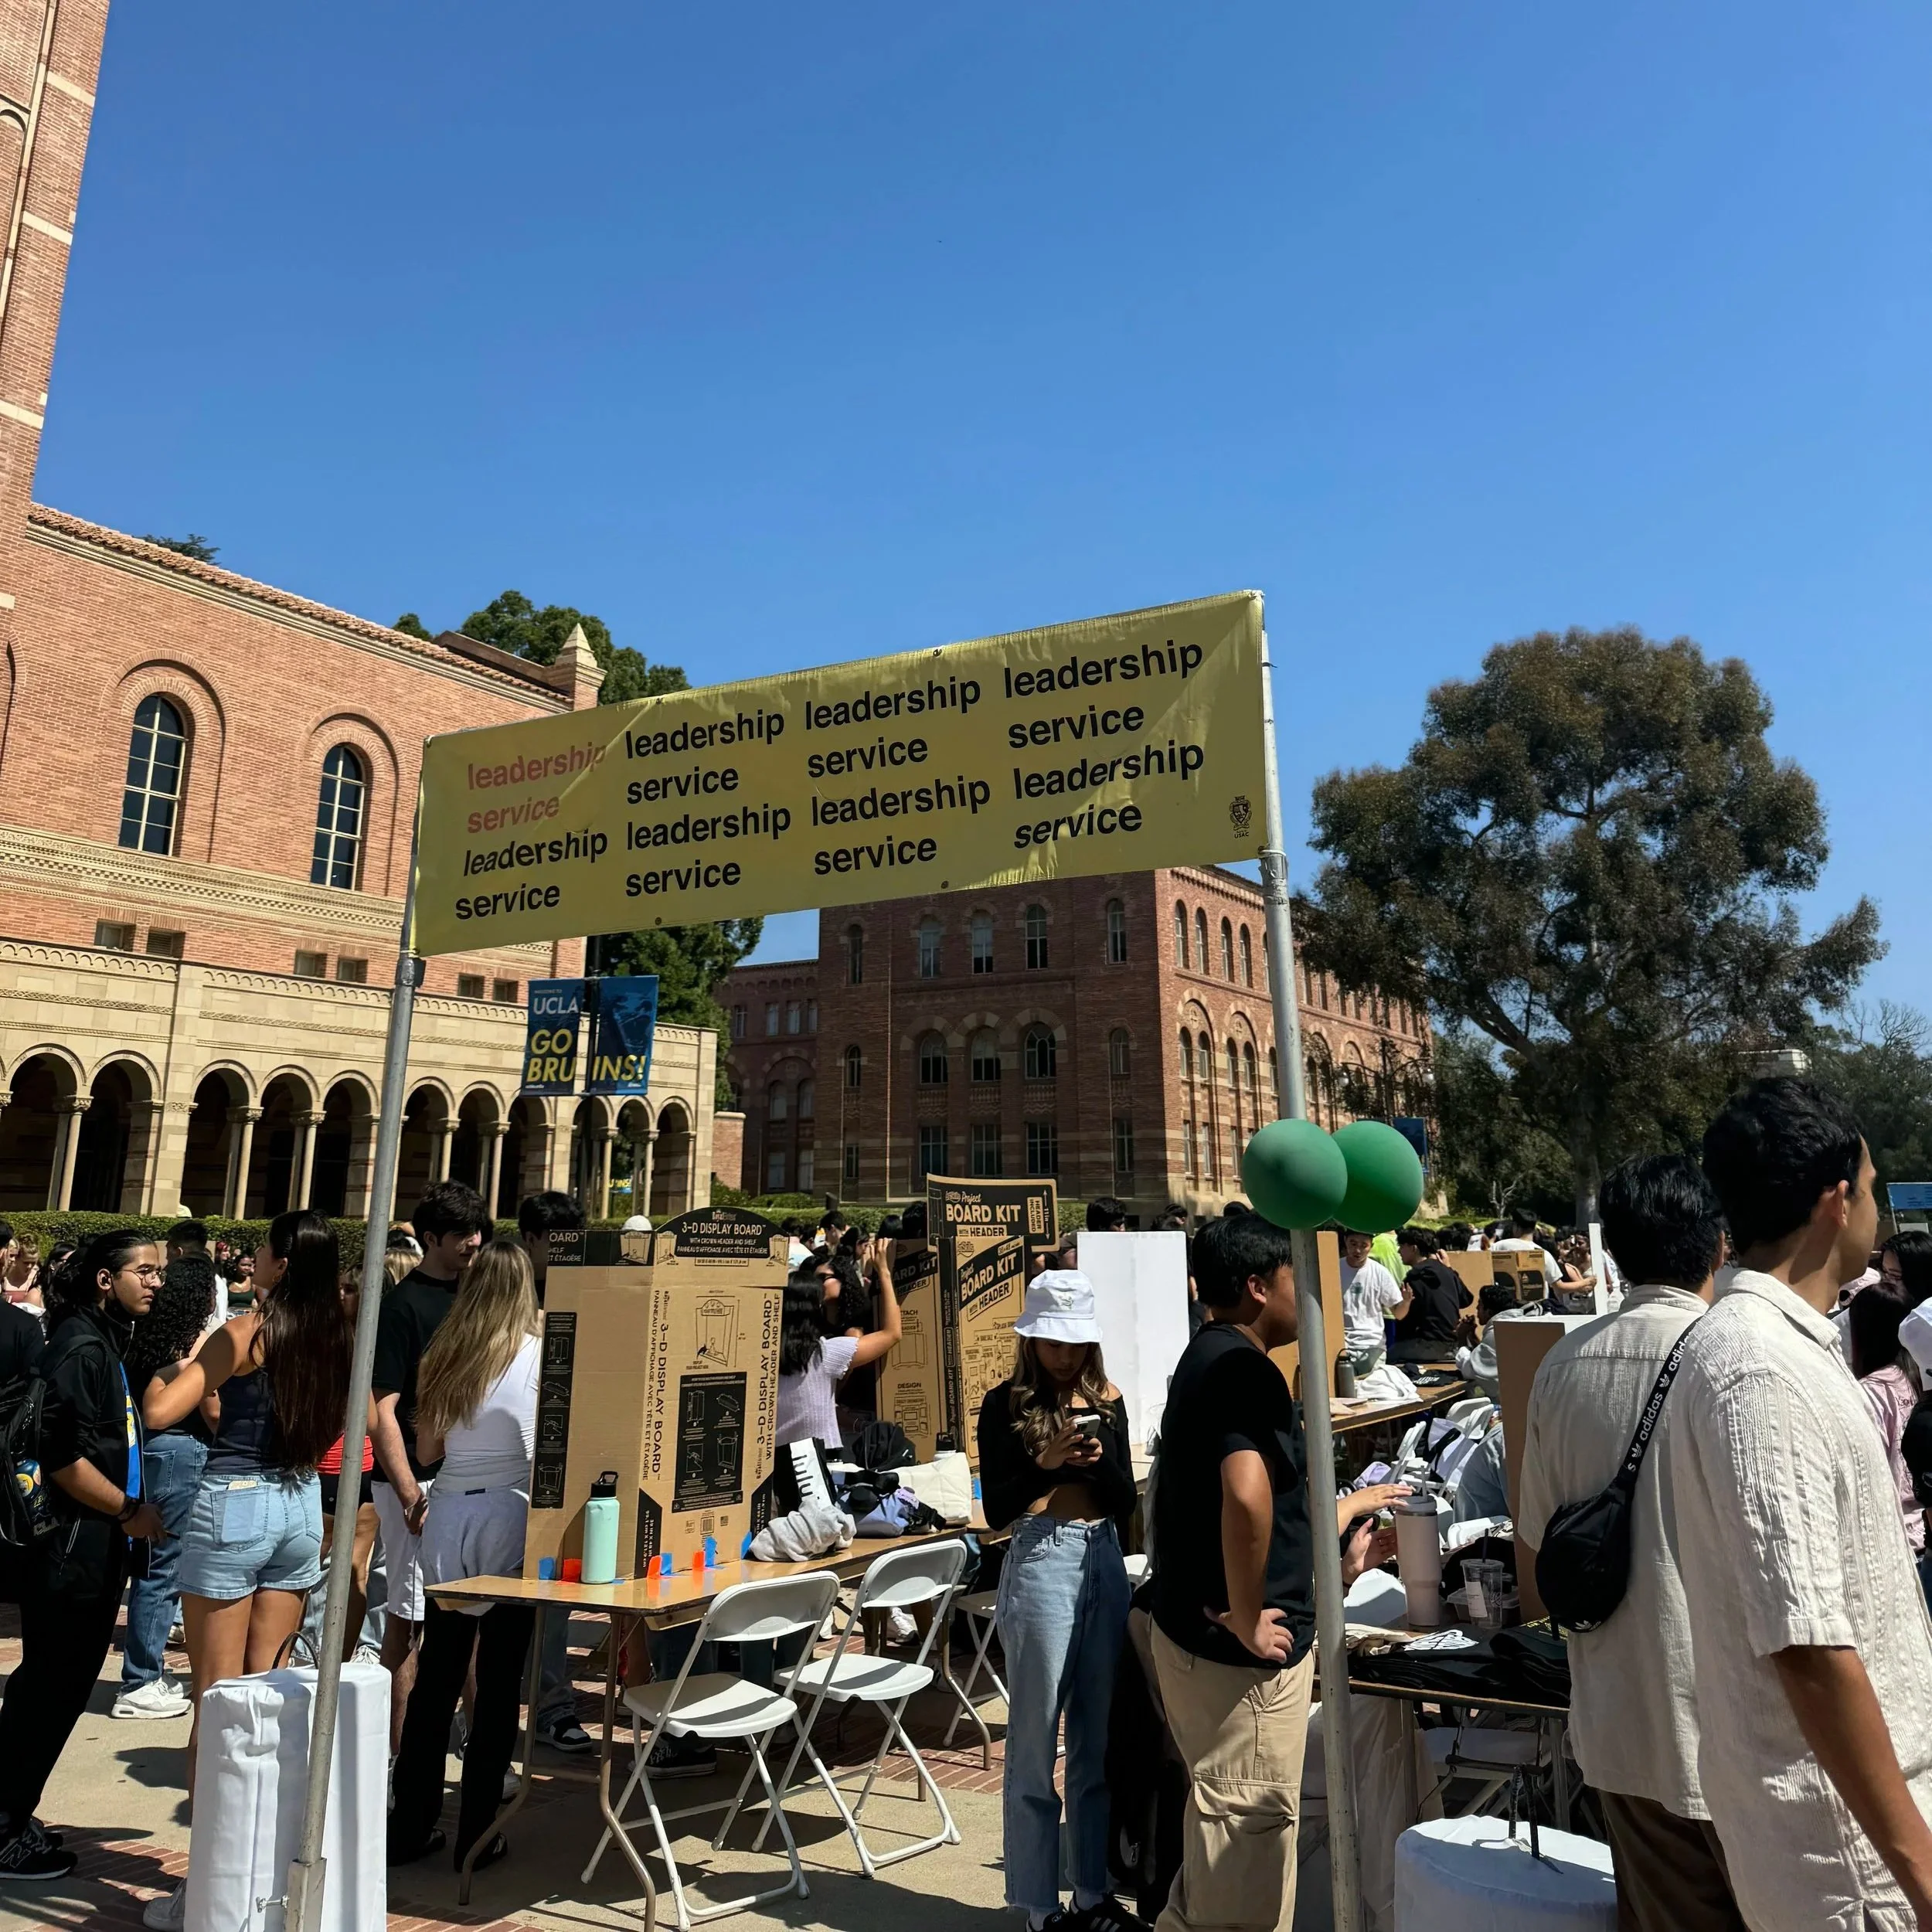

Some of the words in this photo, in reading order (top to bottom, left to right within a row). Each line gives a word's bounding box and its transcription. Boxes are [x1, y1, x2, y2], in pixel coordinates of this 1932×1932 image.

[467, 741, 606, 790] leadership
[625, 709, 784, 760] leadership
[804, 675, 981, 730] leadership
[1004, 639, 1202, 699] leadership
[467, 795, 560, 834] service
[626, 766, 739, 804] service
[808, 736, 928, 778] service
[1008, 704, 1144, 750] service
[463, 828, 607, 877] leadership
[626, 804, 791, 850] leadership
[811, 774, 991, 827] leadership
[1014, 739, 1204, 800] leadership
[455, 884, 560, 920] service
[625, 859, 741, 897] service
[814, 837, 937, 876] service
[1014, 803, 1142, 849] service
[532, 997, 579, 1015] UCLA
[531, 1029, 573, 1055] GO
[526, 1057, 577, 1082] BRU
[592, 1054, 647, 1081] INS!
[961, 1191, 981, 1205] Project
[946, 1203, 992, 1223] BOARD
[995, 1204, 1021, 1223] KIT
[682, 1222, 698, 1233] 3-D
[699, 1223, 732, 1234] DISPLAY
[970, 1227, 1005, 1236] HEADER
[919, 1256, 937, 1273] KIT
[961, 1265, 994, 1301] BOARD
[997, 1252, 1017, 1277] KIT
[978, 1282, 1009, 1310] HEADER
[659, 1323, 668, 1352] 3-D
[1668, 1332, 1691, 1372] adid
[759, 1355, 769, 1411] DISPLAY
[769, 1350, 777, 1389] HEADER
[655, 1357, 667, 1414] DISPLAY
[767, 1391, 775, 1431] CROWN
[1639, 1392, 1663, 1440] adidas
[645, 1431, 651, 1440] ET
[757, 1416, 766, 1444] 3-D
